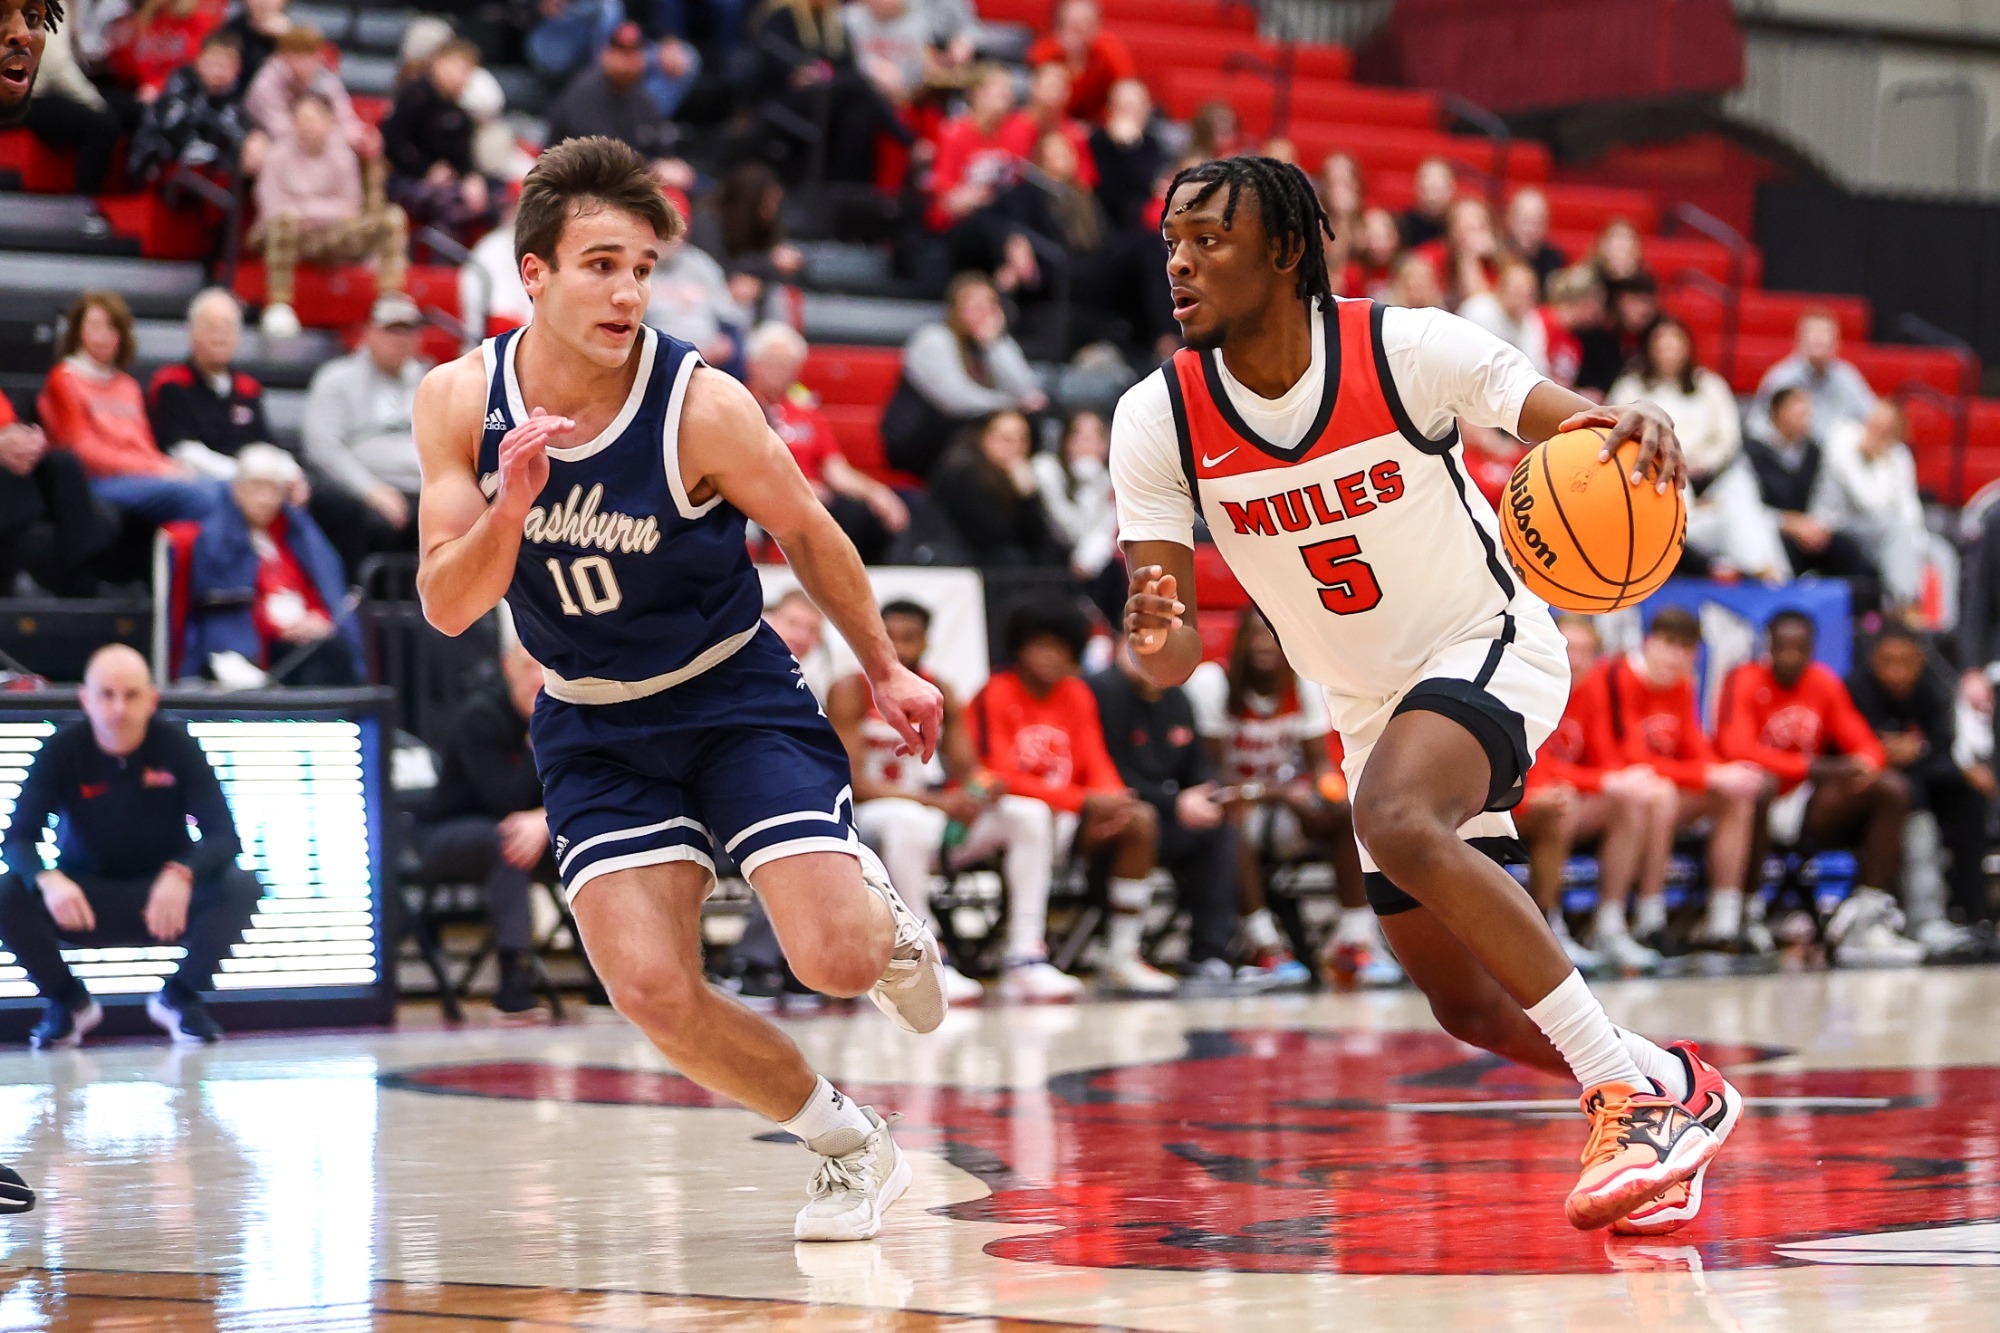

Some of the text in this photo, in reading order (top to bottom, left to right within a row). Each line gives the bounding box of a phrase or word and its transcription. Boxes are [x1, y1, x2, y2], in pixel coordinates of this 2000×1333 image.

[479, 469, 661, 554] ashburn
[1219, 459, 1405, 536] MULES
[1510, 454, 1558, 570] Wilson
[545, 555, 623, 616] 10
[1298, 534, 1383, 616] 5
